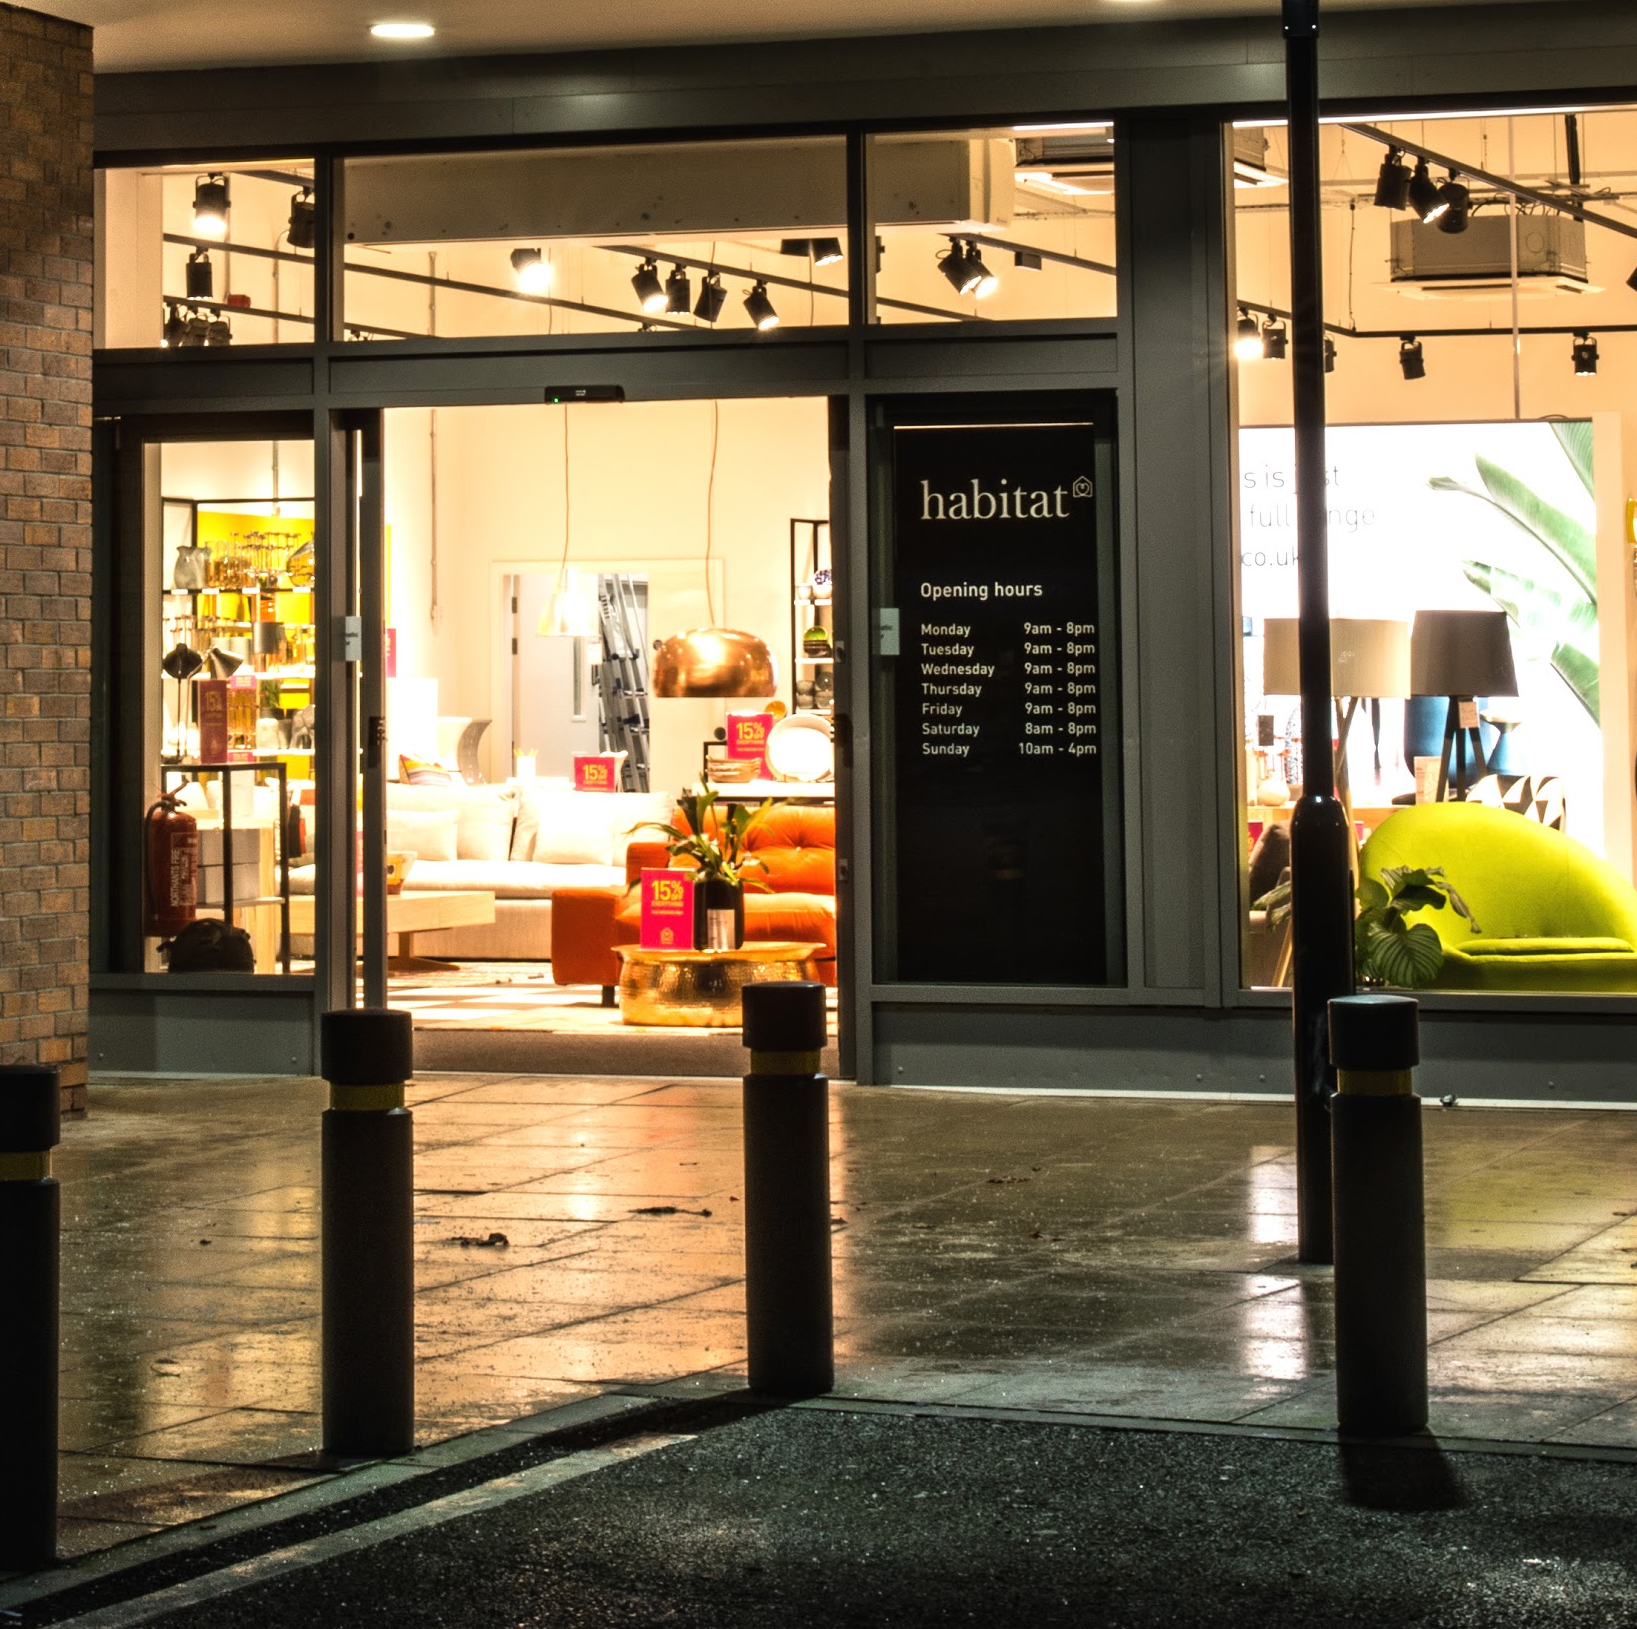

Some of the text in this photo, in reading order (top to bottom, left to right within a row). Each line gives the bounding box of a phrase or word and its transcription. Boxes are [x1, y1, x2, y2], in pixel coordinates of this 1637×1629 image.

[920, 478, 1070, 520] habitat
[1250, 503, 1290, 528] full
[920, 581, 1043, 601] Opening hours
[921, 624, 970, 639] Monday
[1024, 622, 1051, 635] 9am
[1067, 622, 1094, 638] 8pm
[921, 643, 974, 658] Tuesday
[1024, 641, 1052, 654] 9am
[1067, 641, 1095, 657] 8pm
[921, 663, 995, 678] Wednesday
[1024, 661, 1052, 674] 9am
[1067, 661, 1095, 677] 8pm
[922, 683, 982, 698] Thursday
[1025, 681, 1052, 694] 9am
[1067, 681, 1095, 697] 8pm
[922, 703, 962, 718] Friday
[1025, 701, 1053, 714] 9am
[1068, 701, 1096, 717] 8pm
[736, 722, 764, 739] 15%
[922, 723, 979, 738] Saturday
[1025, 721, 1053, 734] 8am
[1068, 721, 1096, 737] 8pm
[922, 743, 969, 758] Sunday
[1019, 741, 1053, 754] 10am
[1068, 741, 1096, 757] 4pm
[583, 764, 608, 780] 15%
[651, 880, 684, 901] 15%
